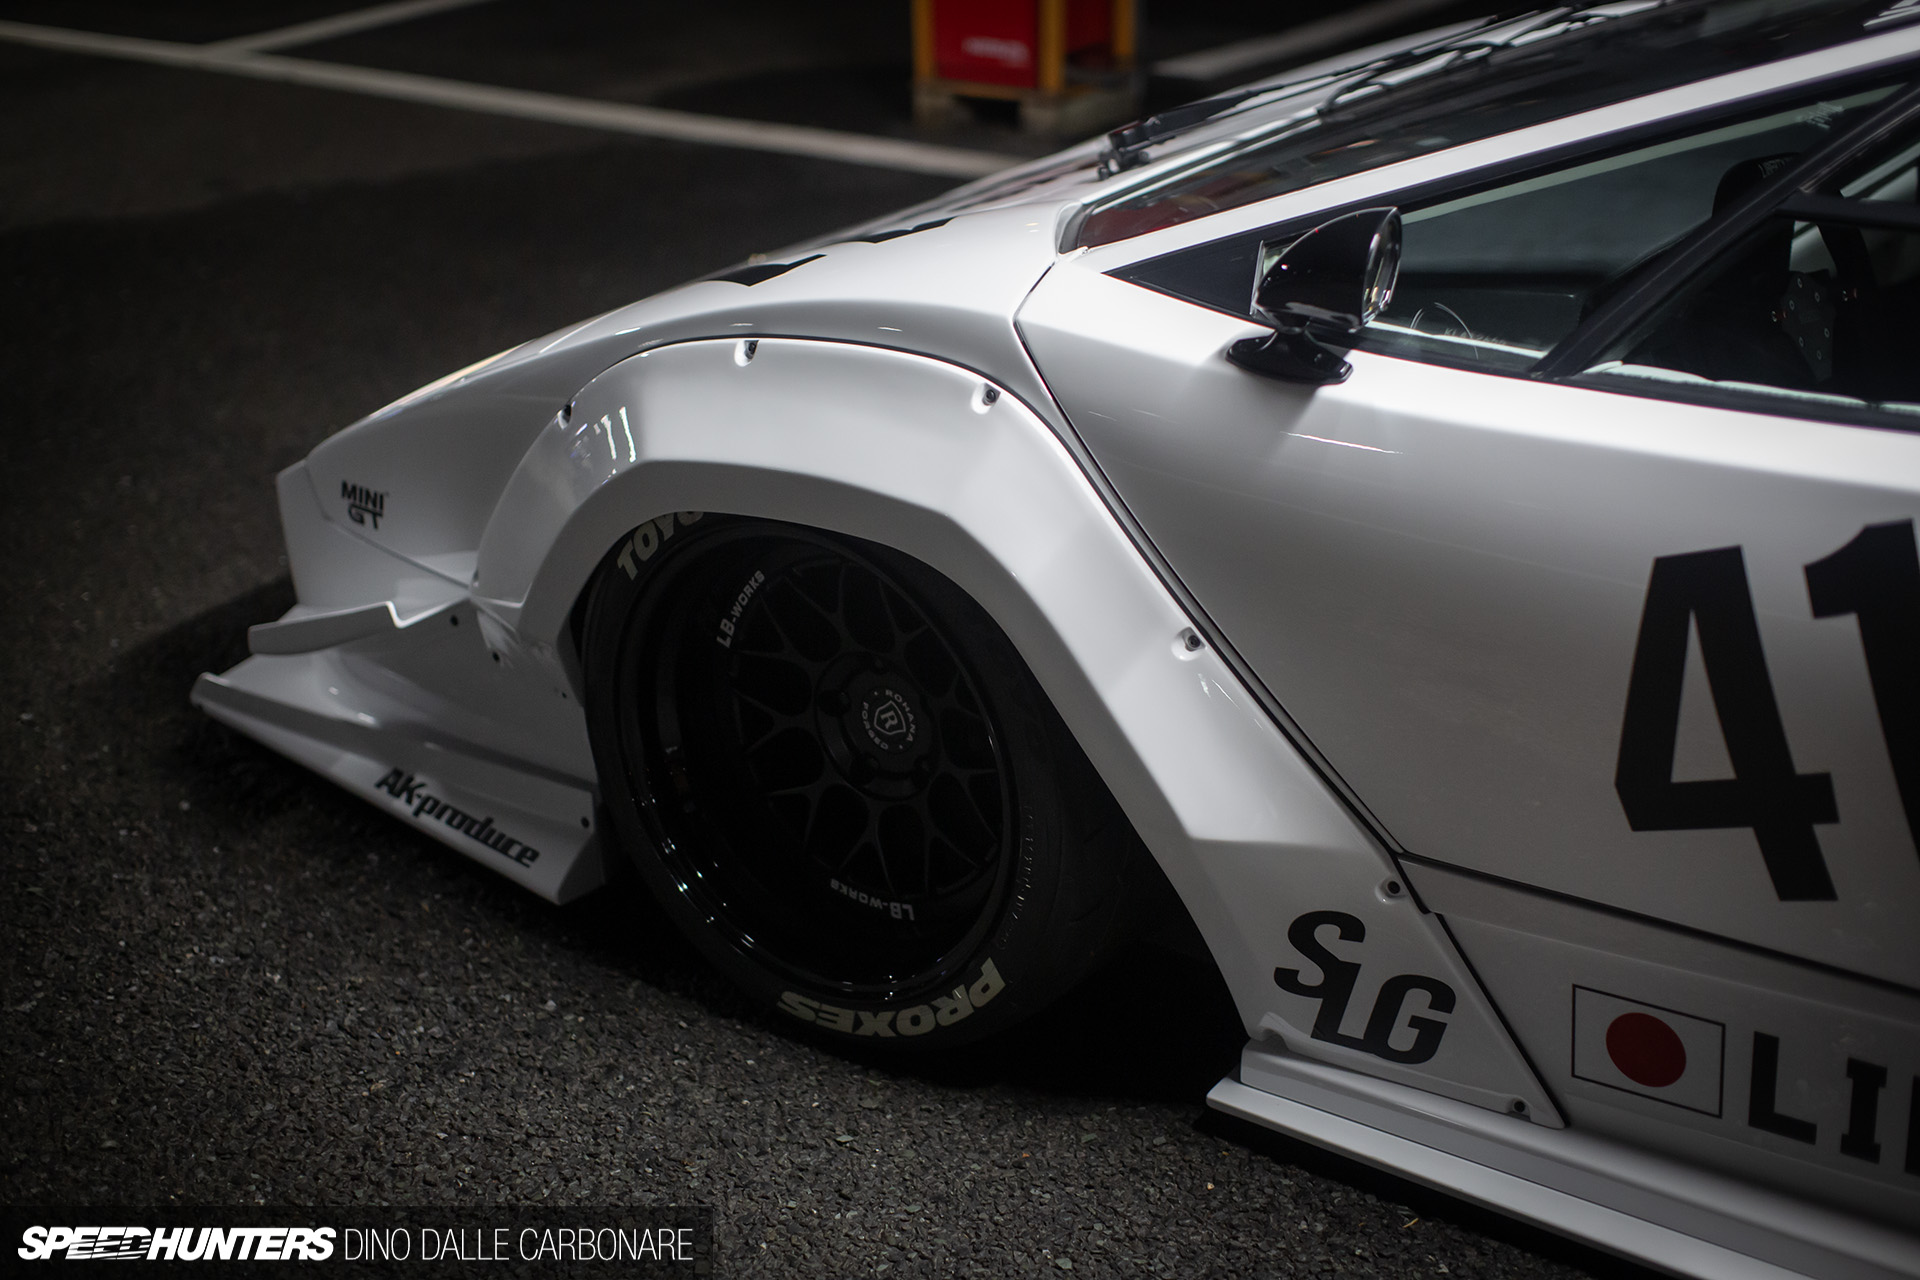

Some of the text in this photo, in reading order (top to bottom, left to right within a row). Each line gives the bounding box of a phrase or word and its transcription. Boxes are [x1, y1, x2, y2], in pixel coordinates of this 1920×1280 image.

[342, 481, 384, 510] MINI
[348, 504, 383, 529] GT
[716, 570, 765, 648] LB-WORKS
[862, 701, 888, 750] FORGED
[885, 689, 916, 742] ROHANA
[376, 766, 540, 868] AK-produce
[830, 878, 915, 921] LB-WORKS
[776, 957, 1006, 1038] PROXES
[1274, 910, 1456, 1065] SLG
[1749, 1031, 1920, 1177] LI
